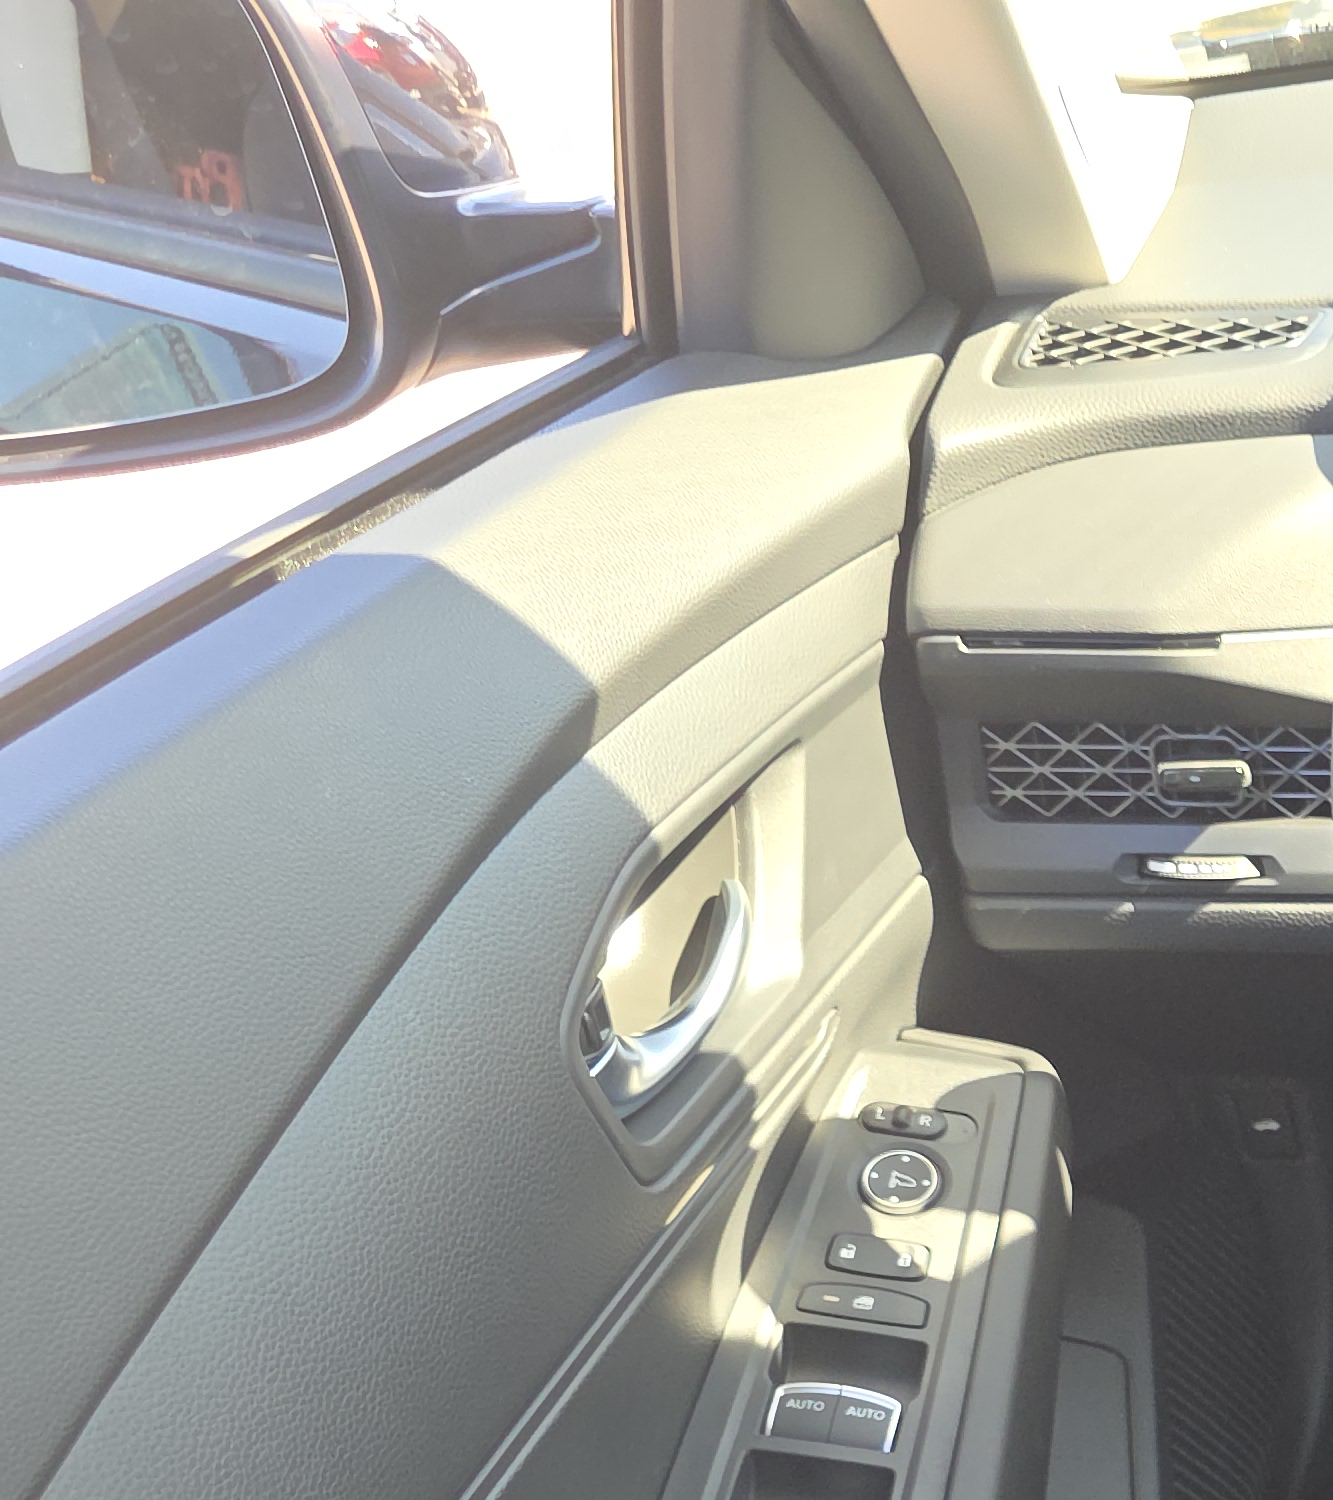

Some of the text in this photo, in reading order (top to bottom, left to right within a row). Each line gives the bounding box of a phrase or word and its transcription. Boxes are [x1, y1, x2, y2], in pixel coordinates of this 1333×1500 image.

[919, 1114, 933, 1127] R
[786, 1398, 825, 1412] AUTO
[845, 1406, 886, 1421] AUTO
